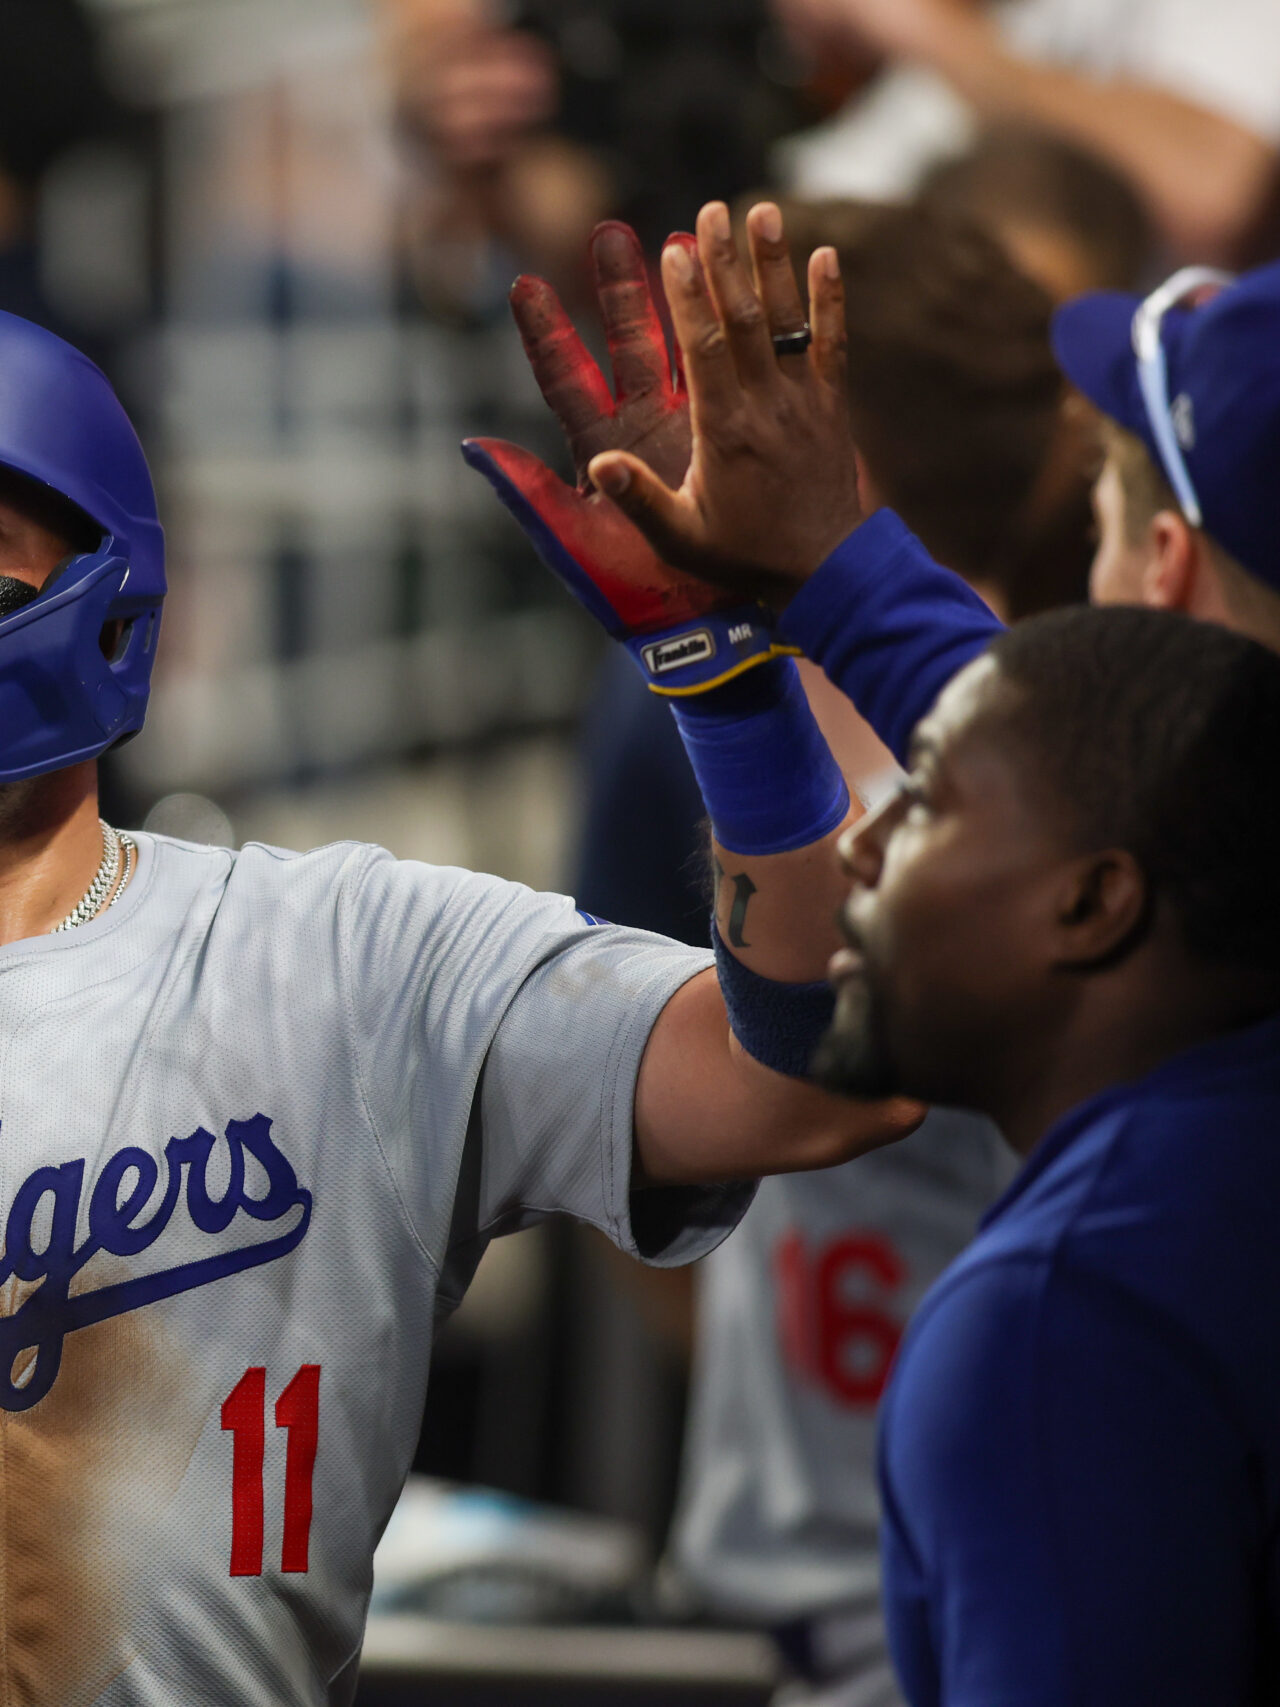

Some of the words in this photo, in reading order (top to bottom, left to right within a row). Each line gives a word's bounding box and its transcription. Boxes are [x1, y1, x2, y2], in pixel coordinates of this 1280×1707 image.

[651, 639, 707, 670] Franklin
[727, 622, 753, 645] MR
[773, 1228, 908, 1408] 16
[220, 1363, 321, 1577] 11
